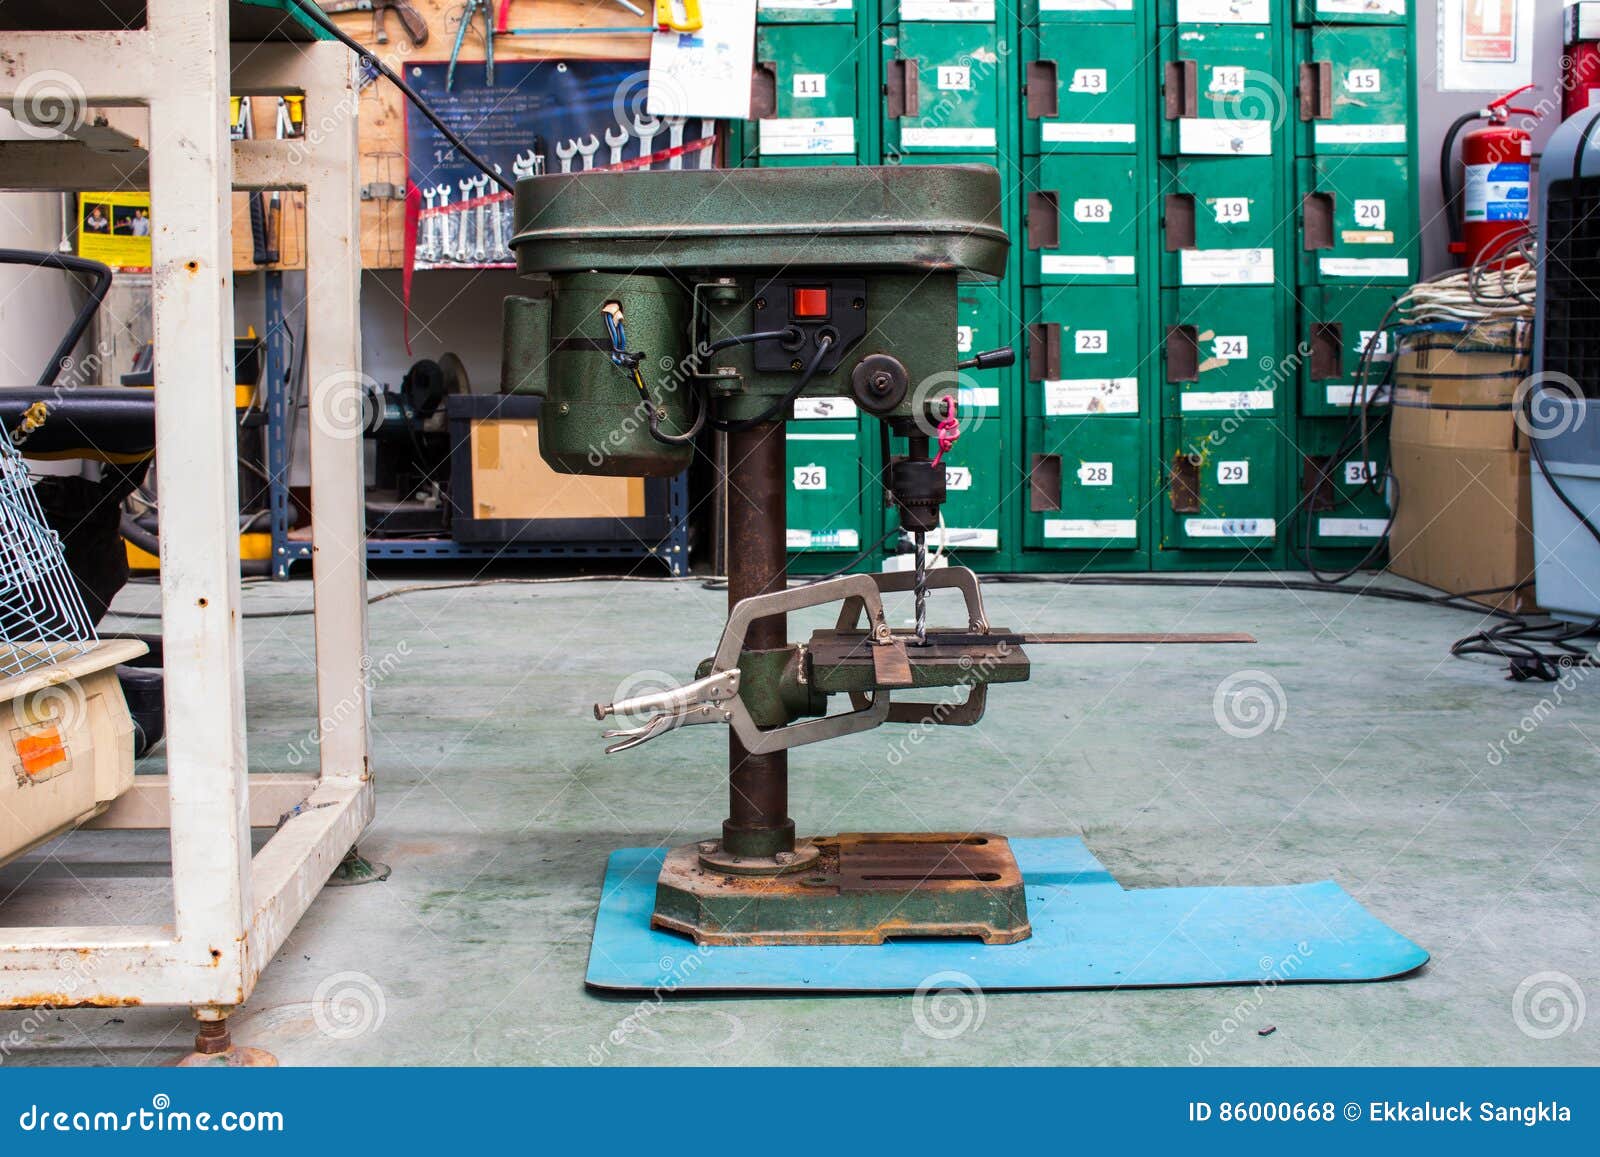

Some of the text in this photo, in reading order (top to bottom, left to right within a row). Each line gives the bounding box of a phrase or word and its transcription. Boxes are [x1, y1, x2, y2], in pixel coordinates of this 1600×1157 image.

[944, 72, 964, 85] 12
[1082, 75, 1101, 88] 13
[1219, 72, 1239, 86] 14
[1355, 75, 1375, 88] 15
[800, 80, 820, 93] 11
[1085, 205, 1104, 218] 18
[1223, 203, 1242, 217] 19
[1361, 205, 1380, 218] 20
[1082, 336, 1101, 349] 23
[1222, 341, 1242, 354] 24
[800, 471, 820, 485] 26
[1087, 467, 1107, 481] 28
[1223, 467, 1243, 480] 29
